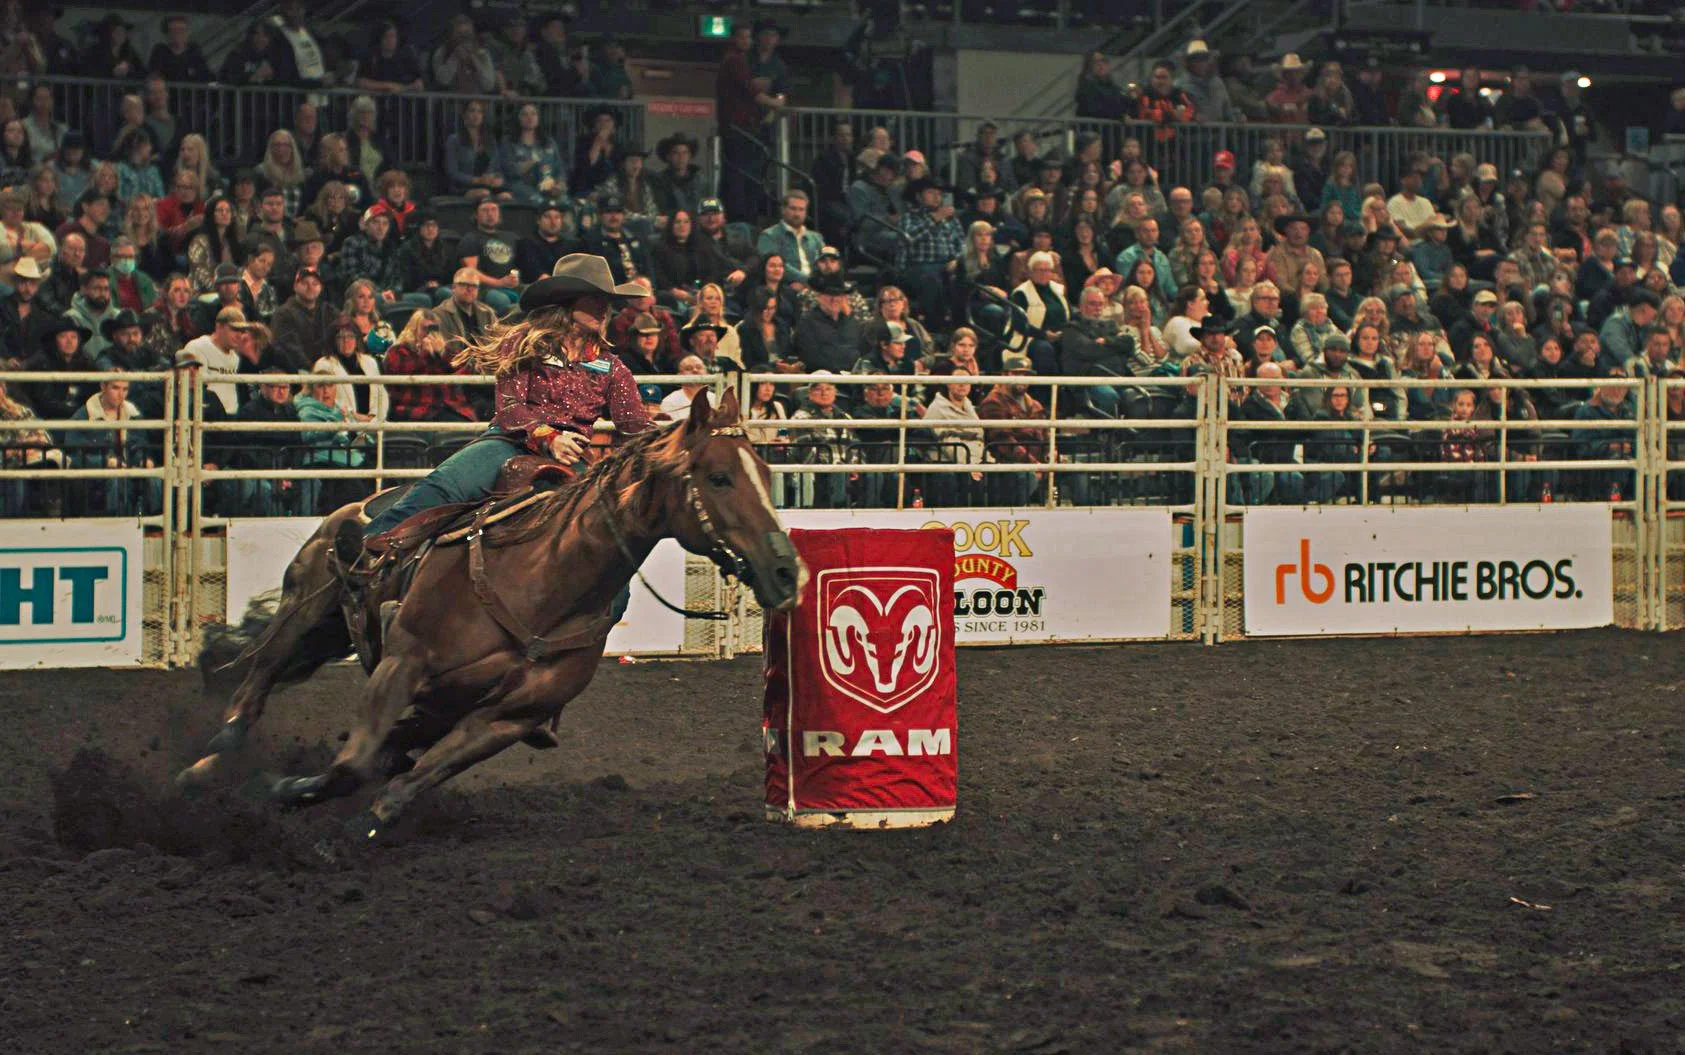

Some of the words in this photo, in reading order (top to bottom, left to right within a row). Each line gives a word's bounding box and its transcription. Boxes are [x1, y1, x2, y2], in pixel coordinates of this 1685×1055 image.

[920, 519, 1033, 557] OOK
[955, 557, 1015, 582] OUNTY
[1345, 561, 1468, 603] RITCHIE
[1477, 559, 1583, 600] BROS.
[954, 588, 1045, 616] LOON
[964, 621, 1007, 632] SINCE
[1014, 620, 1045, 631] 1981
[803, 729, 951, 757] RAM
